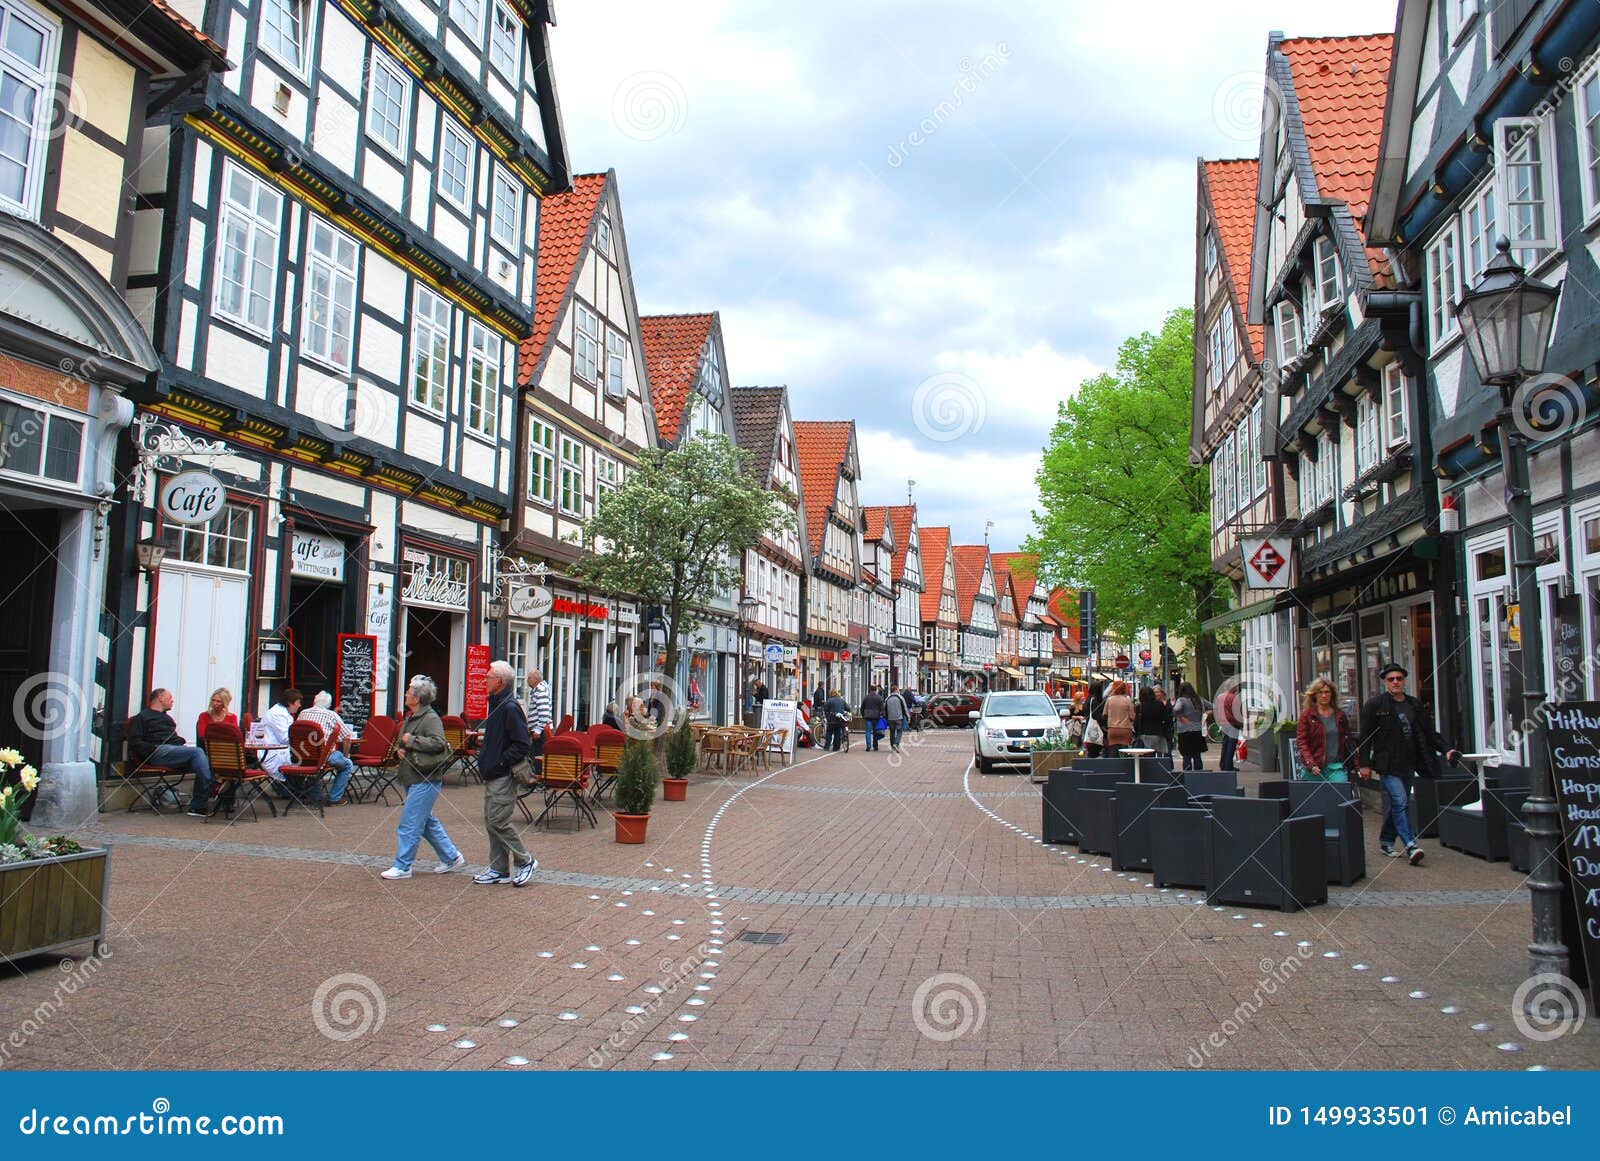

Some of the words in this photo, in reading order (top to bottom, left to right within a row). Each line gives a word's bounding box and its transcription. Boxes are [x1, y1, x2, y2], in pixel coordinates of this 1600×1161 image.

[168, 486, 217, 519] Café
[402, 566, 468, 605] Noblesse
[519, 598, 552, 613] Noblesse
[370, 611, 388, 627] Café
[342, 639, 372, 655] Salate
[1573, 734, 1592, 745] bis
[1555, 747, 1600, 769] Sams
